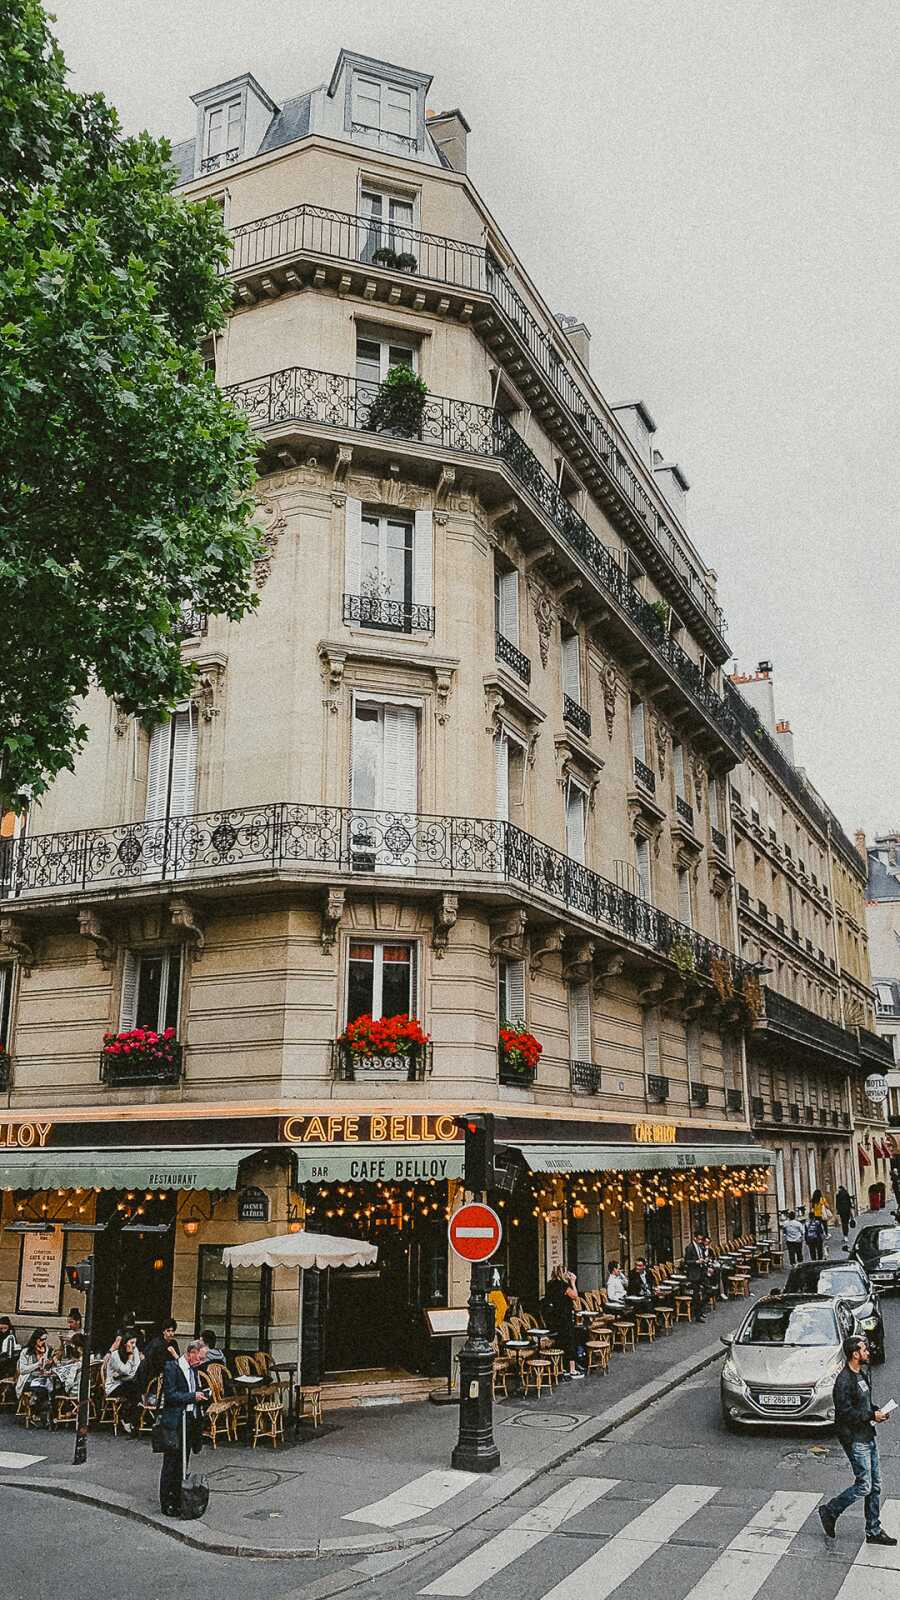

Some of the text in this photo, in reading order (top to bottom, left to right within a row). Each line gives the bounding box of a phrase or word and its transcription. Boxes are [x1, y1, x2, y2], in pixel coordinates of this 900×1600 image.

[311, 1166, 329, 1177] BAR
[395, 1159, 447, 1177] BELLOY
[149, 1174, 198, 1185] RESTAURANT
